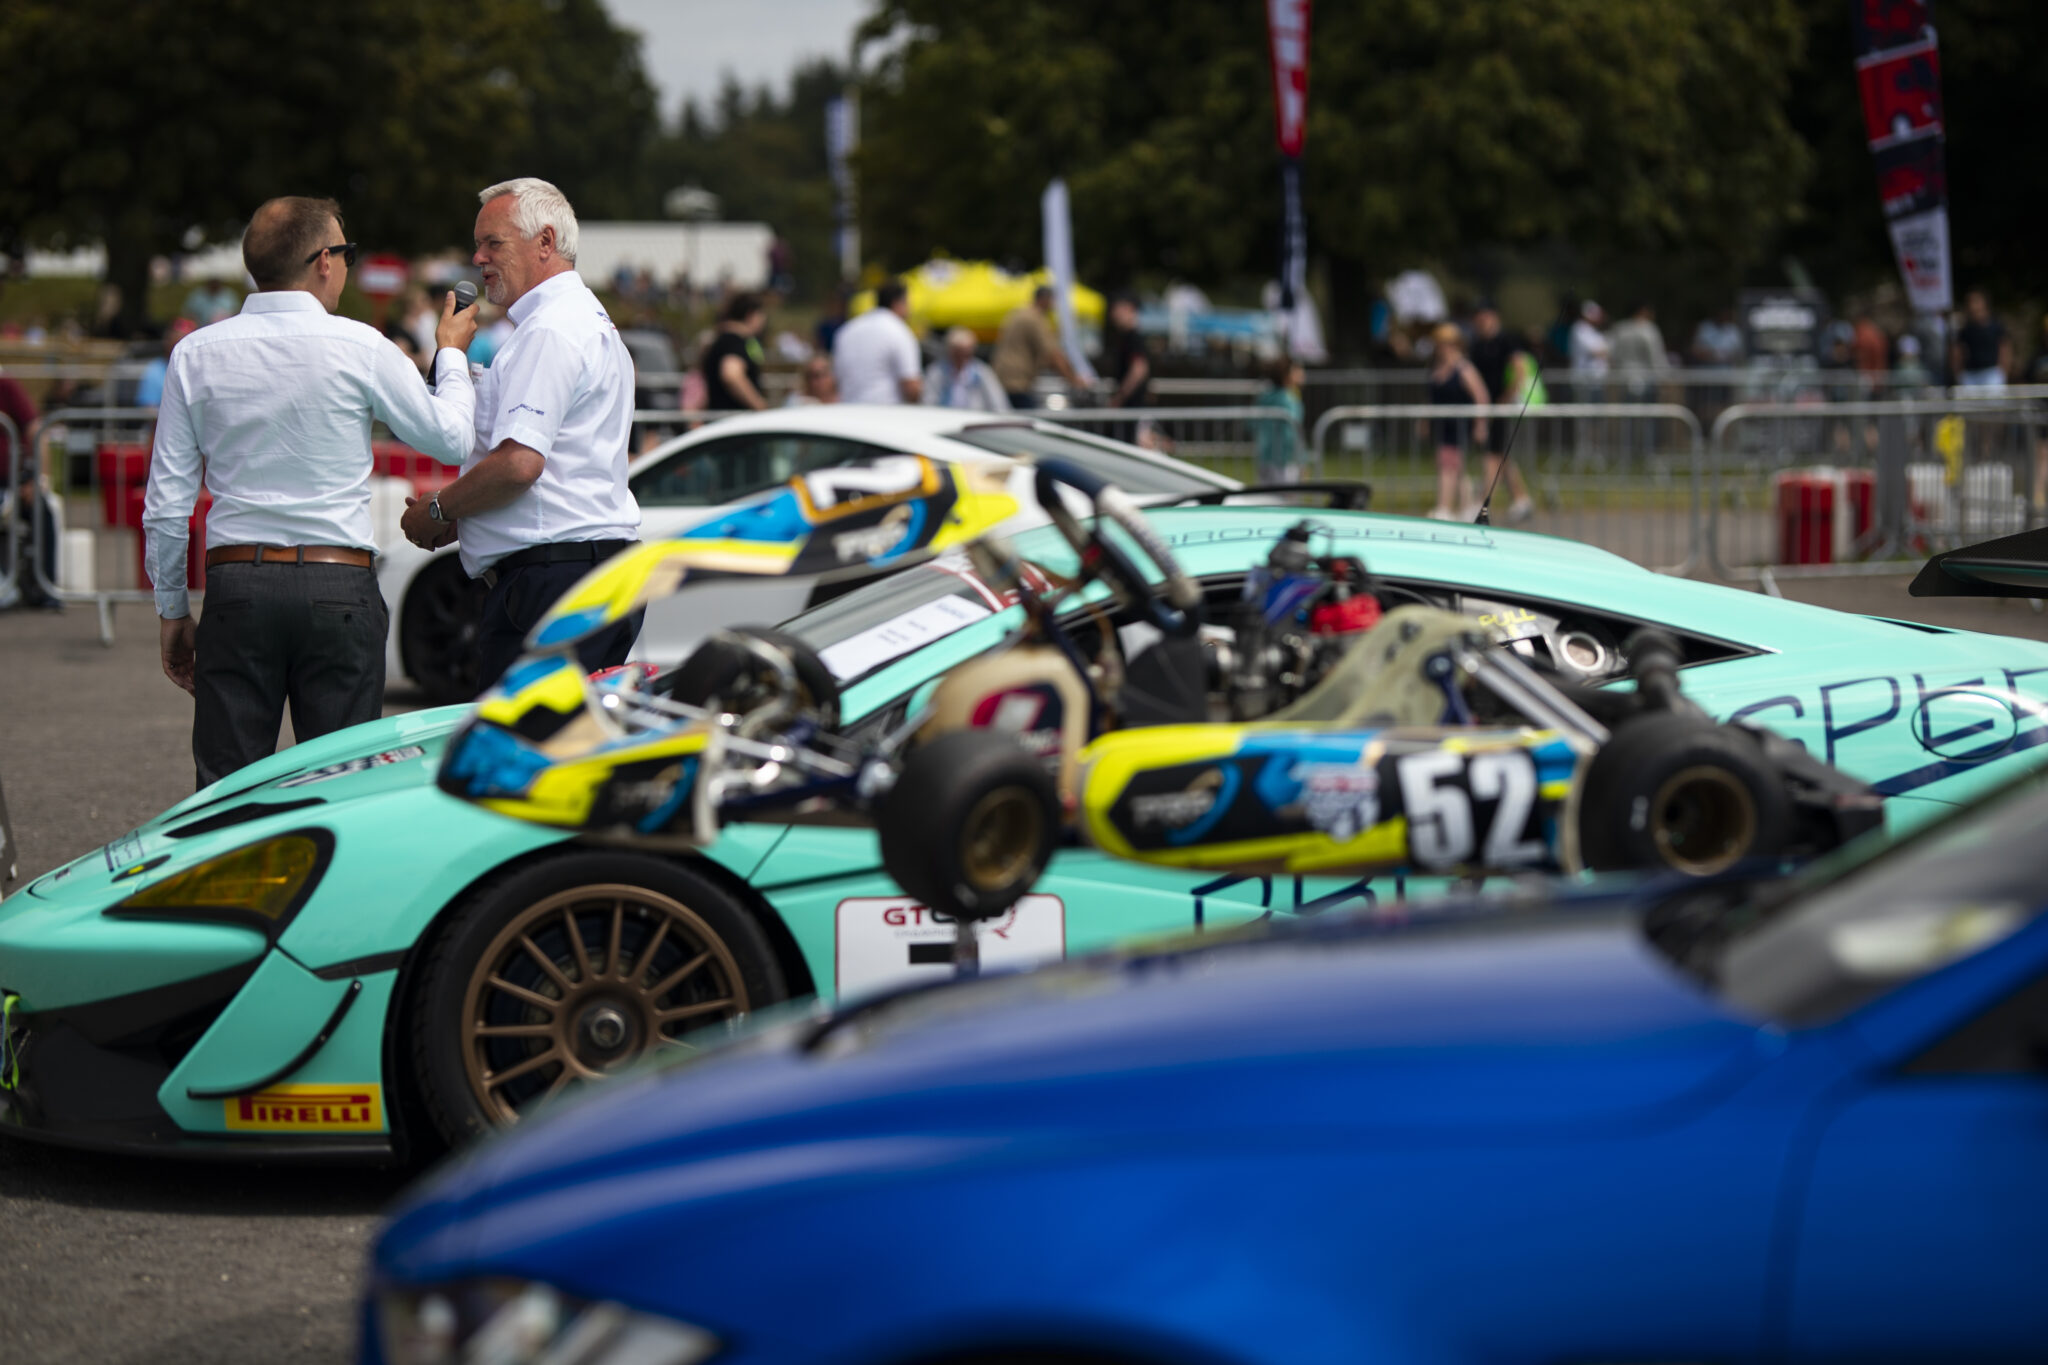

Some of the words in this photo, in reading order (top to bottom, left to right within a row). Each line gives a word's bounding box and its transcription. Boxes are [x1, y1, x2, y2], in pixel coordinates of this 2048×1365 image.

[1478, 607, 1537, 627] PULL
[1397, 750, 1549, 868] 52
[238, 1093, 372, 1123] PIRELLI
